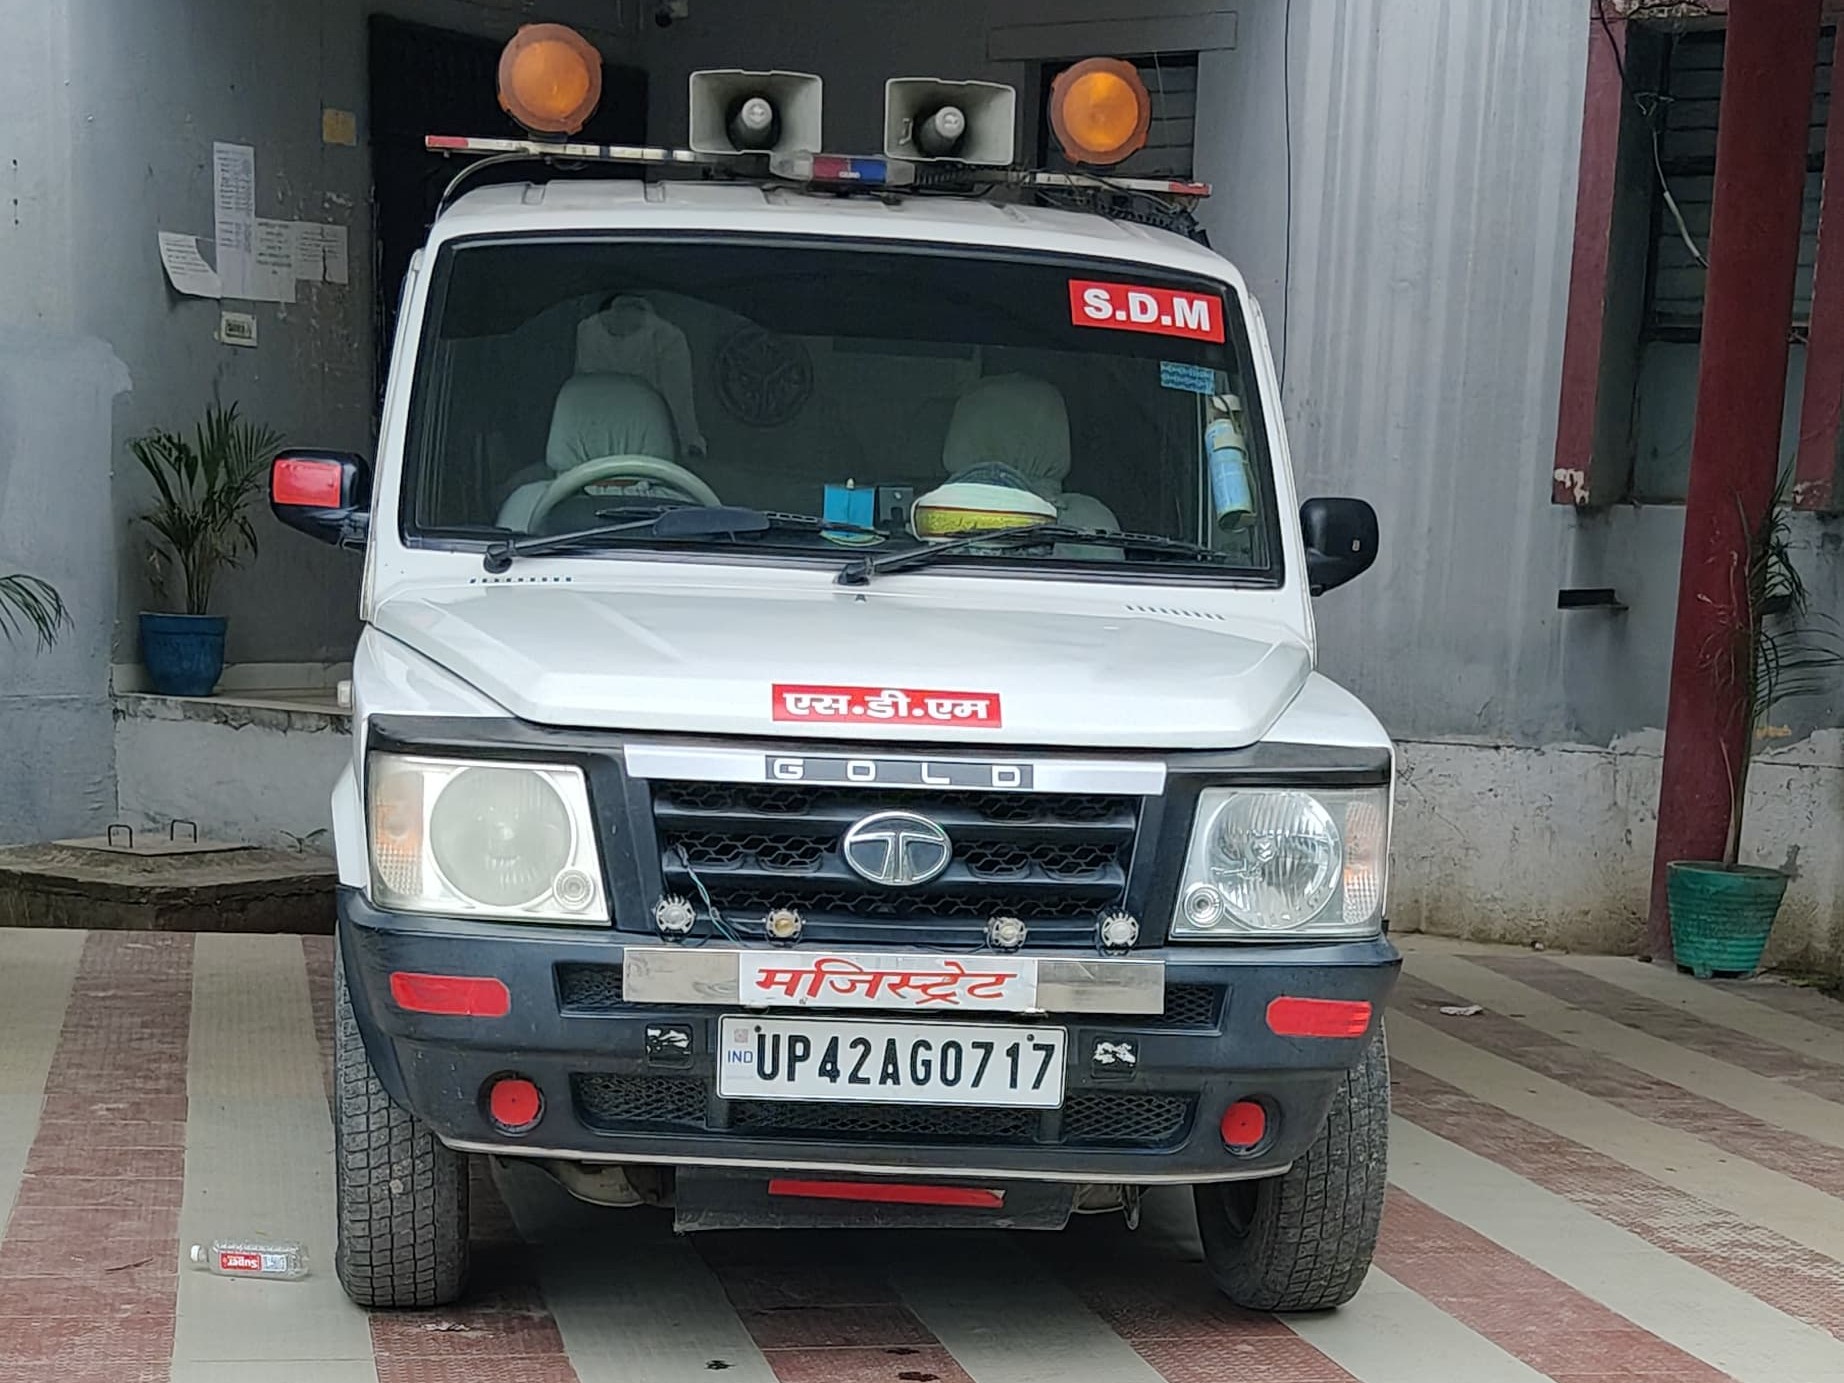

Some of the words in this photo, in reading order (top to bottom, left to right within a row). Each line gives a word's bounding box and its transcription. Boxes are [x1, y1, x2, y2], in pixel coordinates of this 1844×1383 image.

[1083, 288, 1211, 332] S.D.M
[783, 689, 990, 720] एस.डी.एम
[773, 758, 1021, 787] GOLD
[755, 957, 1018, 1005] मजिस्ट्रेट
[727, 1050, 754, 1064] IND
[756, 1033, 1057, 1090] UP42AG0717
